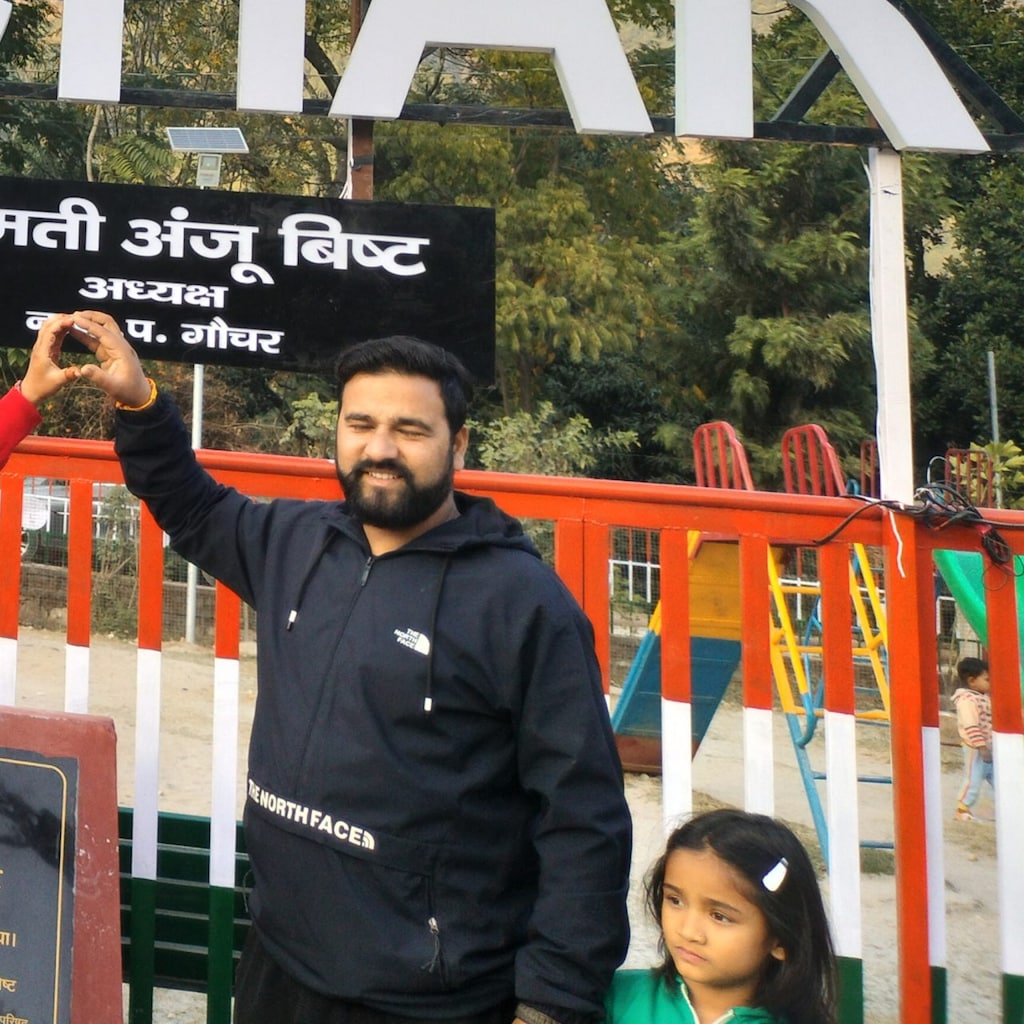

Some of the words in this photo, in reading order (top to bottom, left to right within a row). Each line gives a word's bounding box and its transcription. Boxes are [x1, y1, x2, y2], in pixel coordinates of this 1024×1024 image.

[120, 206, 275, 284] अंजू
[278, 212, 431, 276] बिष्ट
[78, 276, 228, 309] अध्यक्ष
[180, 316, 285, 354] गौचर
[259, 789, 309, 825] NORTH
[309, 809, 363, 847] FACE
